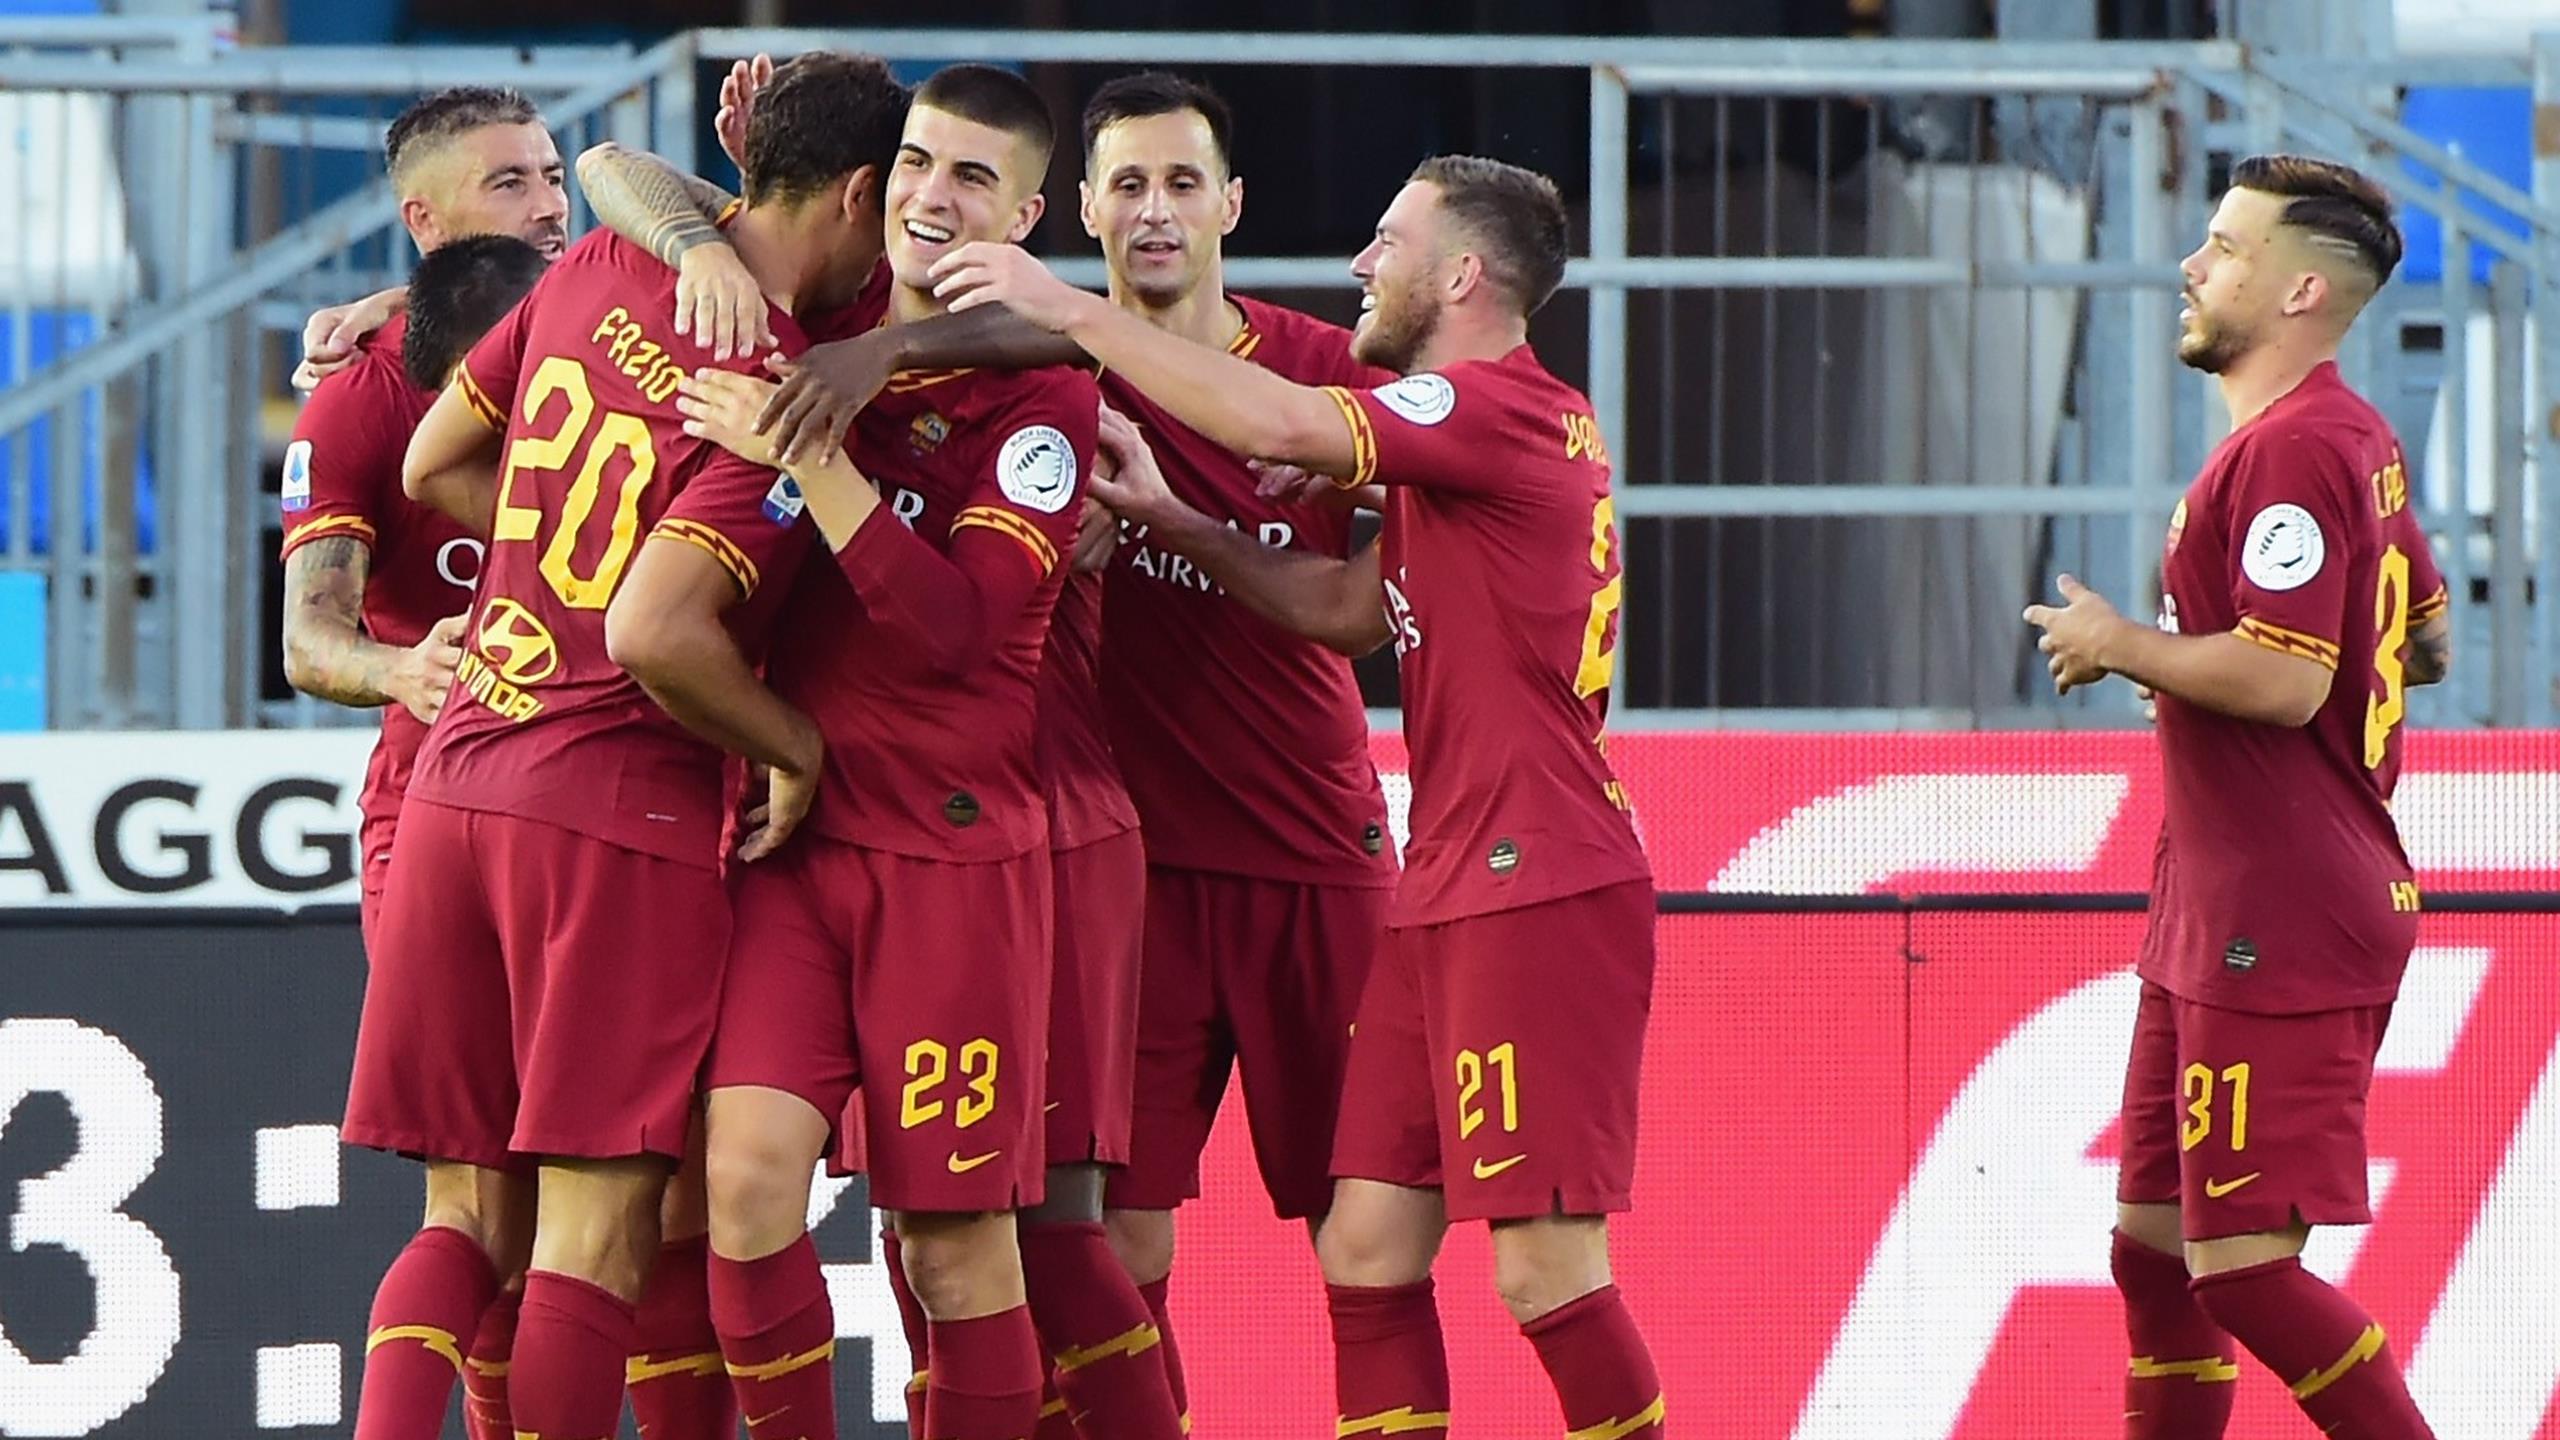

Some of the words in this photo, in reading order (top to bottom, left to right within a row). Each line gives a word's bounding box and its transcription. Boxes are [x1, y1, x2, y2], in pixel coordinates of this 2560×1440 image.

[591, 306, 686, 404] FAZIO
[494, 355, 657, 610] 20
[899, 1037, 1000, 1130] 23
[1455, 1041, 1520, 1140] 21
[2181, 1061, 2250, 1153] 31
